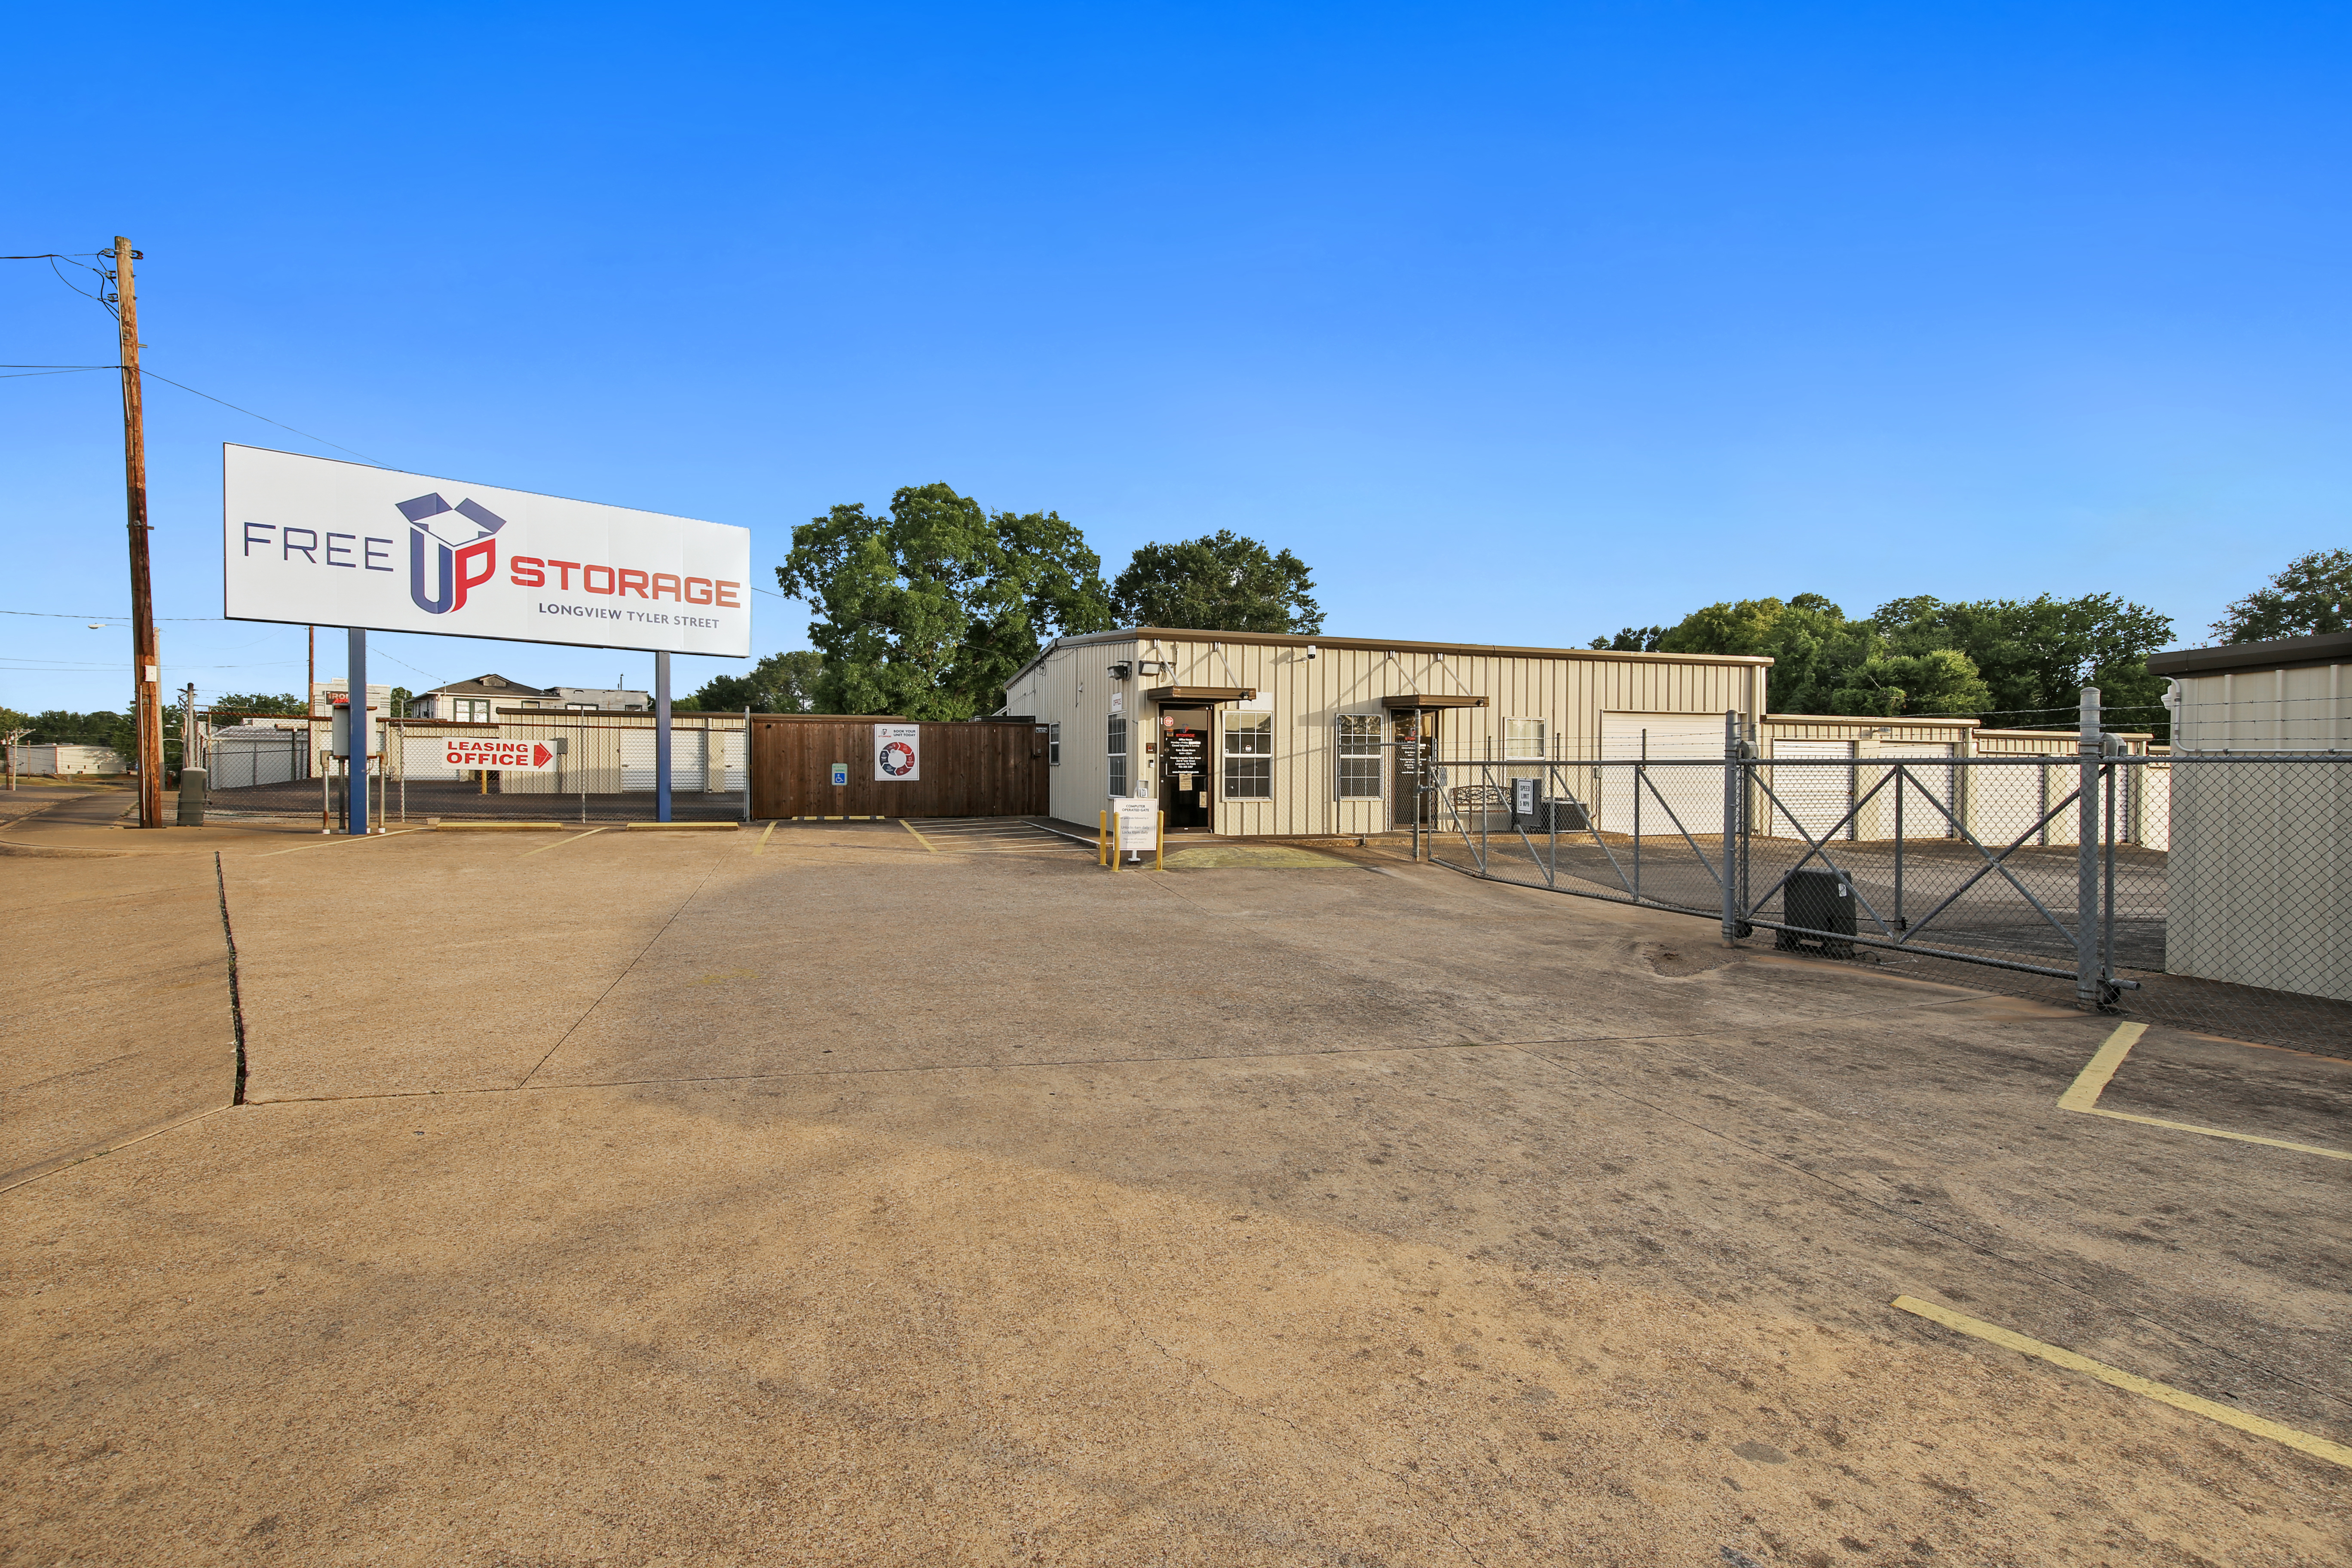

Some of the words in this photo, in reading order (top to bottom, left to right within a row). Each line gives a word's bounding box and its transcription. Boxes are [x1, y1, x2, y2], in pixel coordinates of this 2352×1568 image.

[244, 522, 394, 572] FREE
[410, 527, 496, 614] UP
[511, 555, 740, 608] STORAGE
[539, 603, 622, 619] LONGVIEW
[627, 611, 669, 624] TYLER
[674, 616, 719, 628] STREET
[448, 741, 528, 752] LEASING
[447, 752, 528, 765] OFFICE
